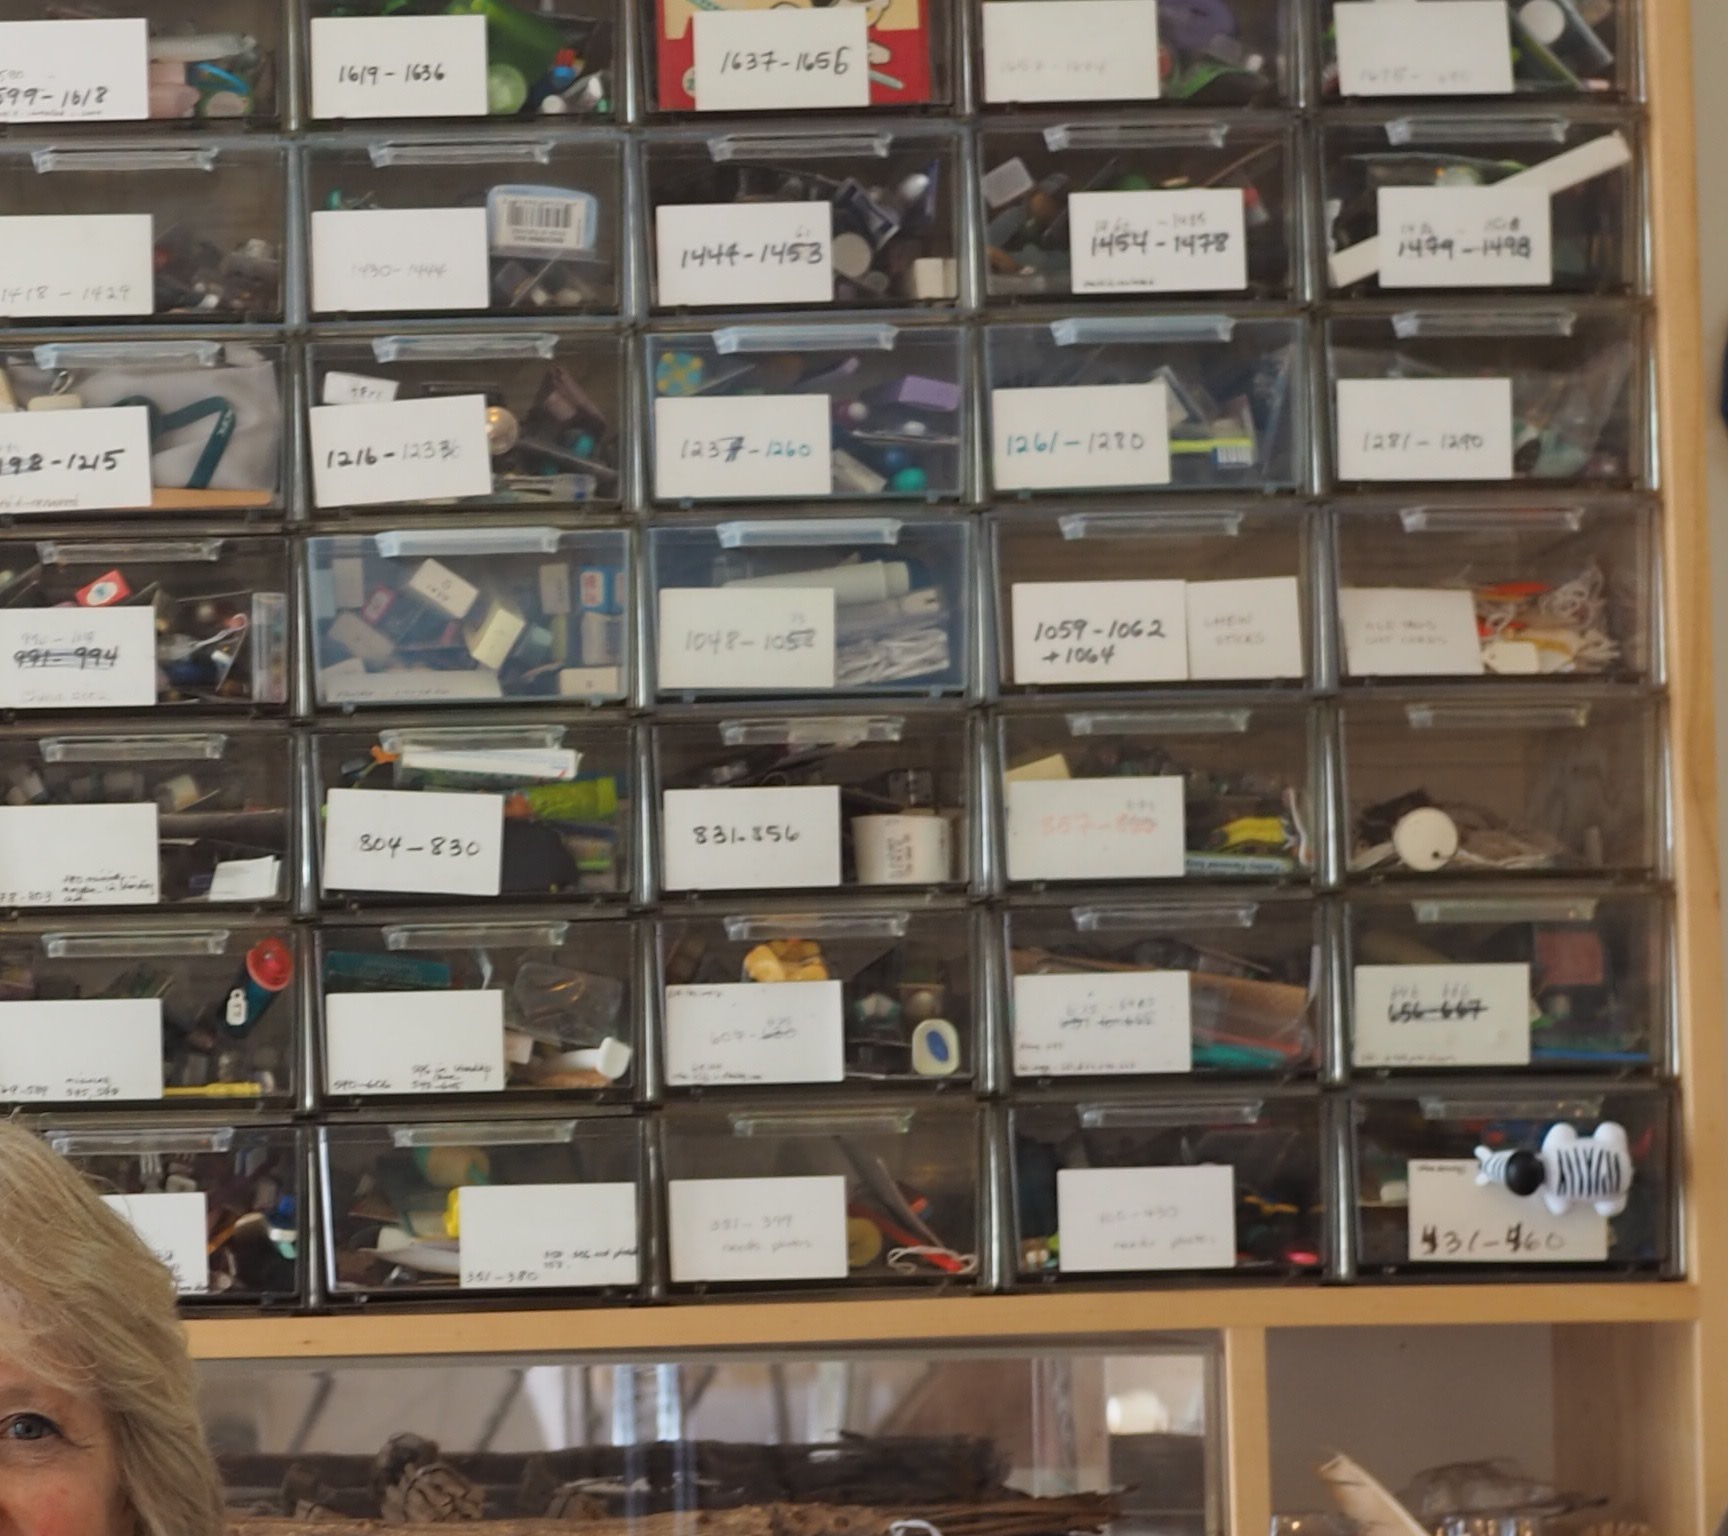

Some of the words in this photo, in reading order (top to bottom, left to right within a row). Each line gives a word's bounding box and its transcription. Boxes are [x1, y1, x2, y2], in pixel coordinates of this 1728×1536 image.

[720, 45, 851, 76] 1637-1656
[338, 63, 446, 86] 1619-1636
[680, 241, 824, 269] 1444-1453
[1090, 229, 1231, 257] 1454-1478
[1006, 430, 1146, 457] 1261-1280
[1362, 431, 1485, 452] 1281-1290
[1033, 616, 1168, 641] 1059-1062
[359, 833, 481, 859] 804-830
[692, 824, 800, 846] 831-856
